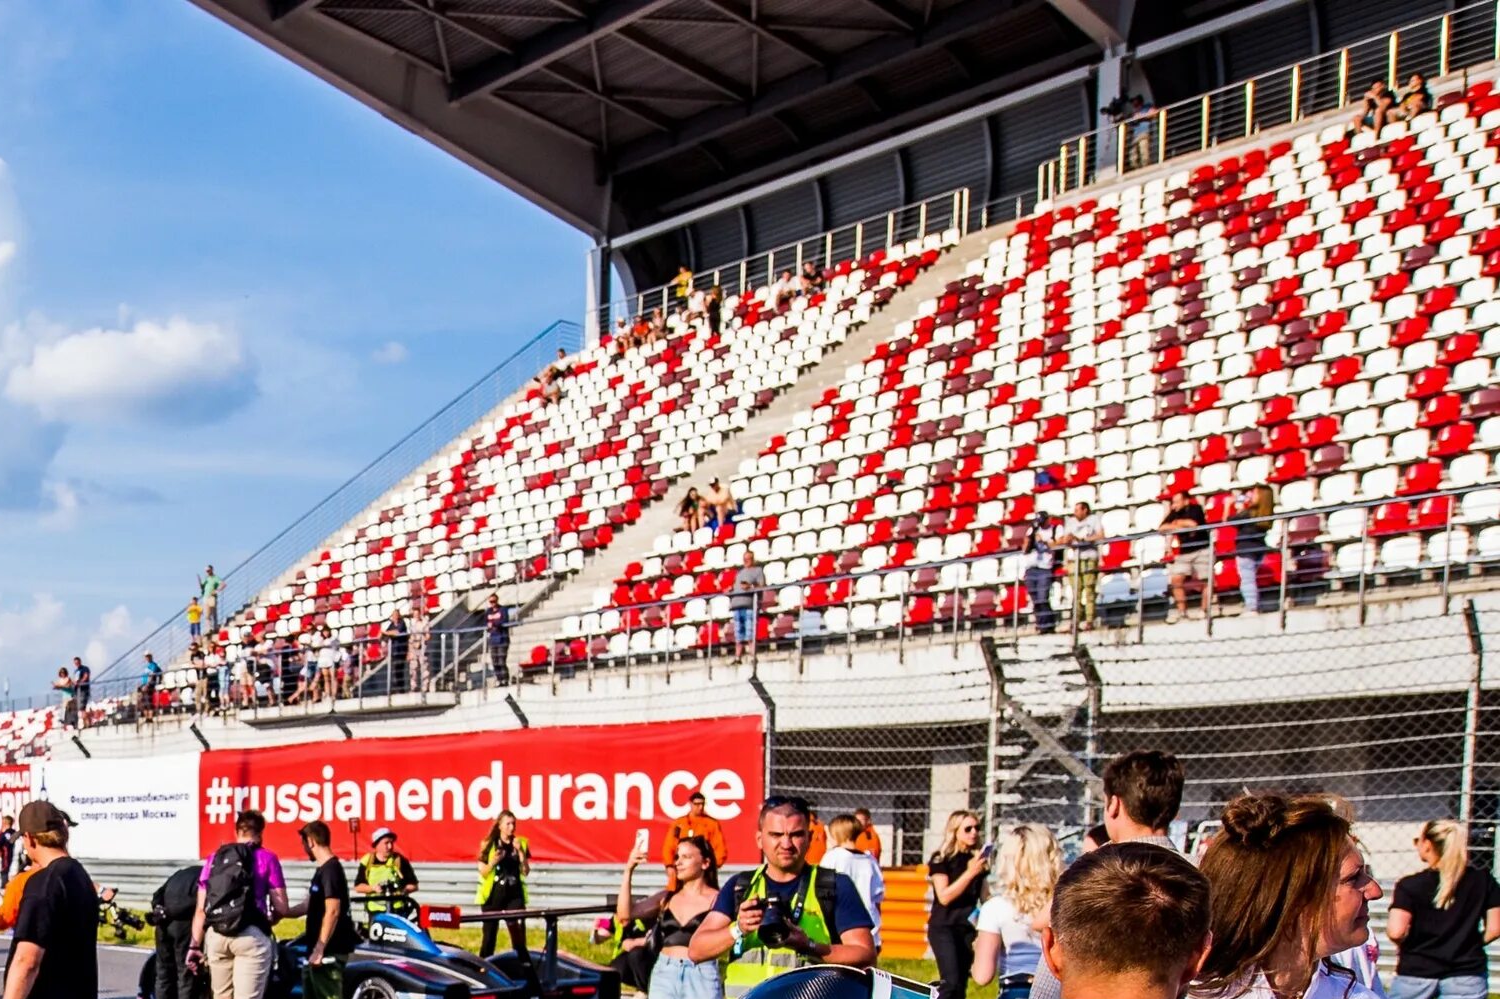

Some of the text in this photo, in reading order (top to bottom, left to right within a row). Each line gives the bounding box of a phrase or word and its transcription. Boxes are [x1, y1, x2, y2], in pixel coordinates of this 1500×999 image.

[70, 792, 190, 805] Федерация автомобильного
[205, 760, 746, 824] #russianendurance
[81, 809, 177, 820] спорта города Москвы
